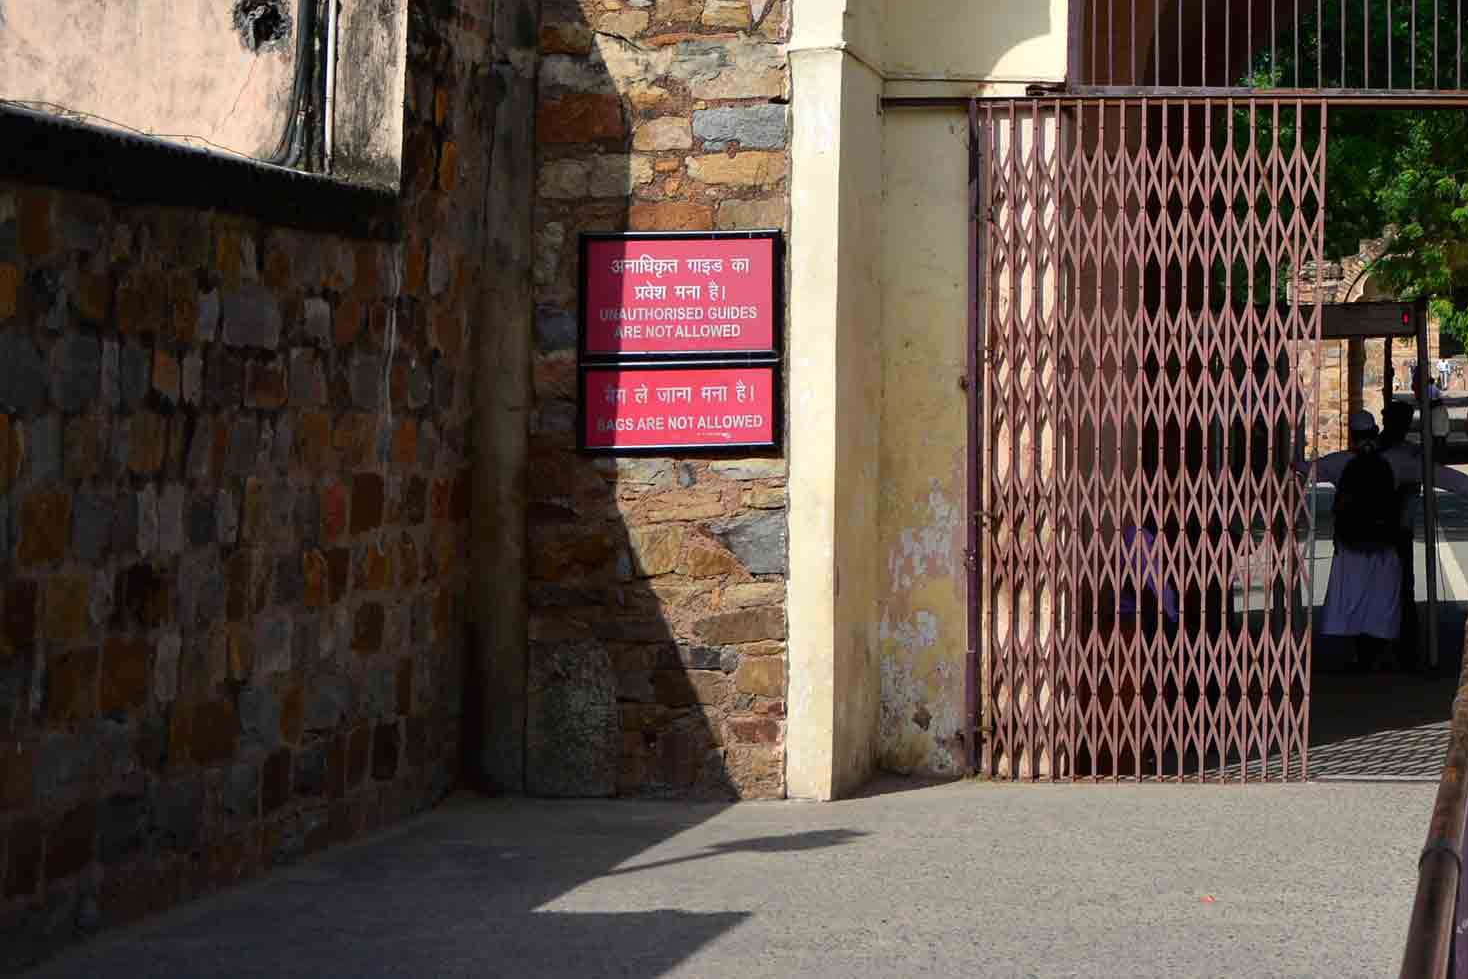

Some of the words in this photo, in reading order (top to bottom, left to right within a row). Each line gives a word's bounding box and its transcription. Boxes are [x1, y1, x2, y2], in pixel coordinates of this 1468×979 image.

[611, 254, 679, 278] अनाधिकृत
[686, 259, 722, 275] गाइड
[731, 258, 750, 273] का
[634, 280, 667, 301] प्रवेश
[674, 284, 701, 300] मना
[600, 306, 704, 321] UNAUTHORISED
[708, 305, 758, 320] GUIDES
[614, 325, 642, 339] ARE
[645, 325, 672, 338] NOT
[675, 324, 741, 338] ALLOWED
[634, 383, 648, 404] ले
[656, 386, 692, 404] जाना
[701, 385, 728, 403] मना
[597, 417, 634, 432] BAGS
[637, 416, 664, 431] ARE
[668, 415, 694, 430] NOT
[697, 414, 763, 429] ALLOWED
